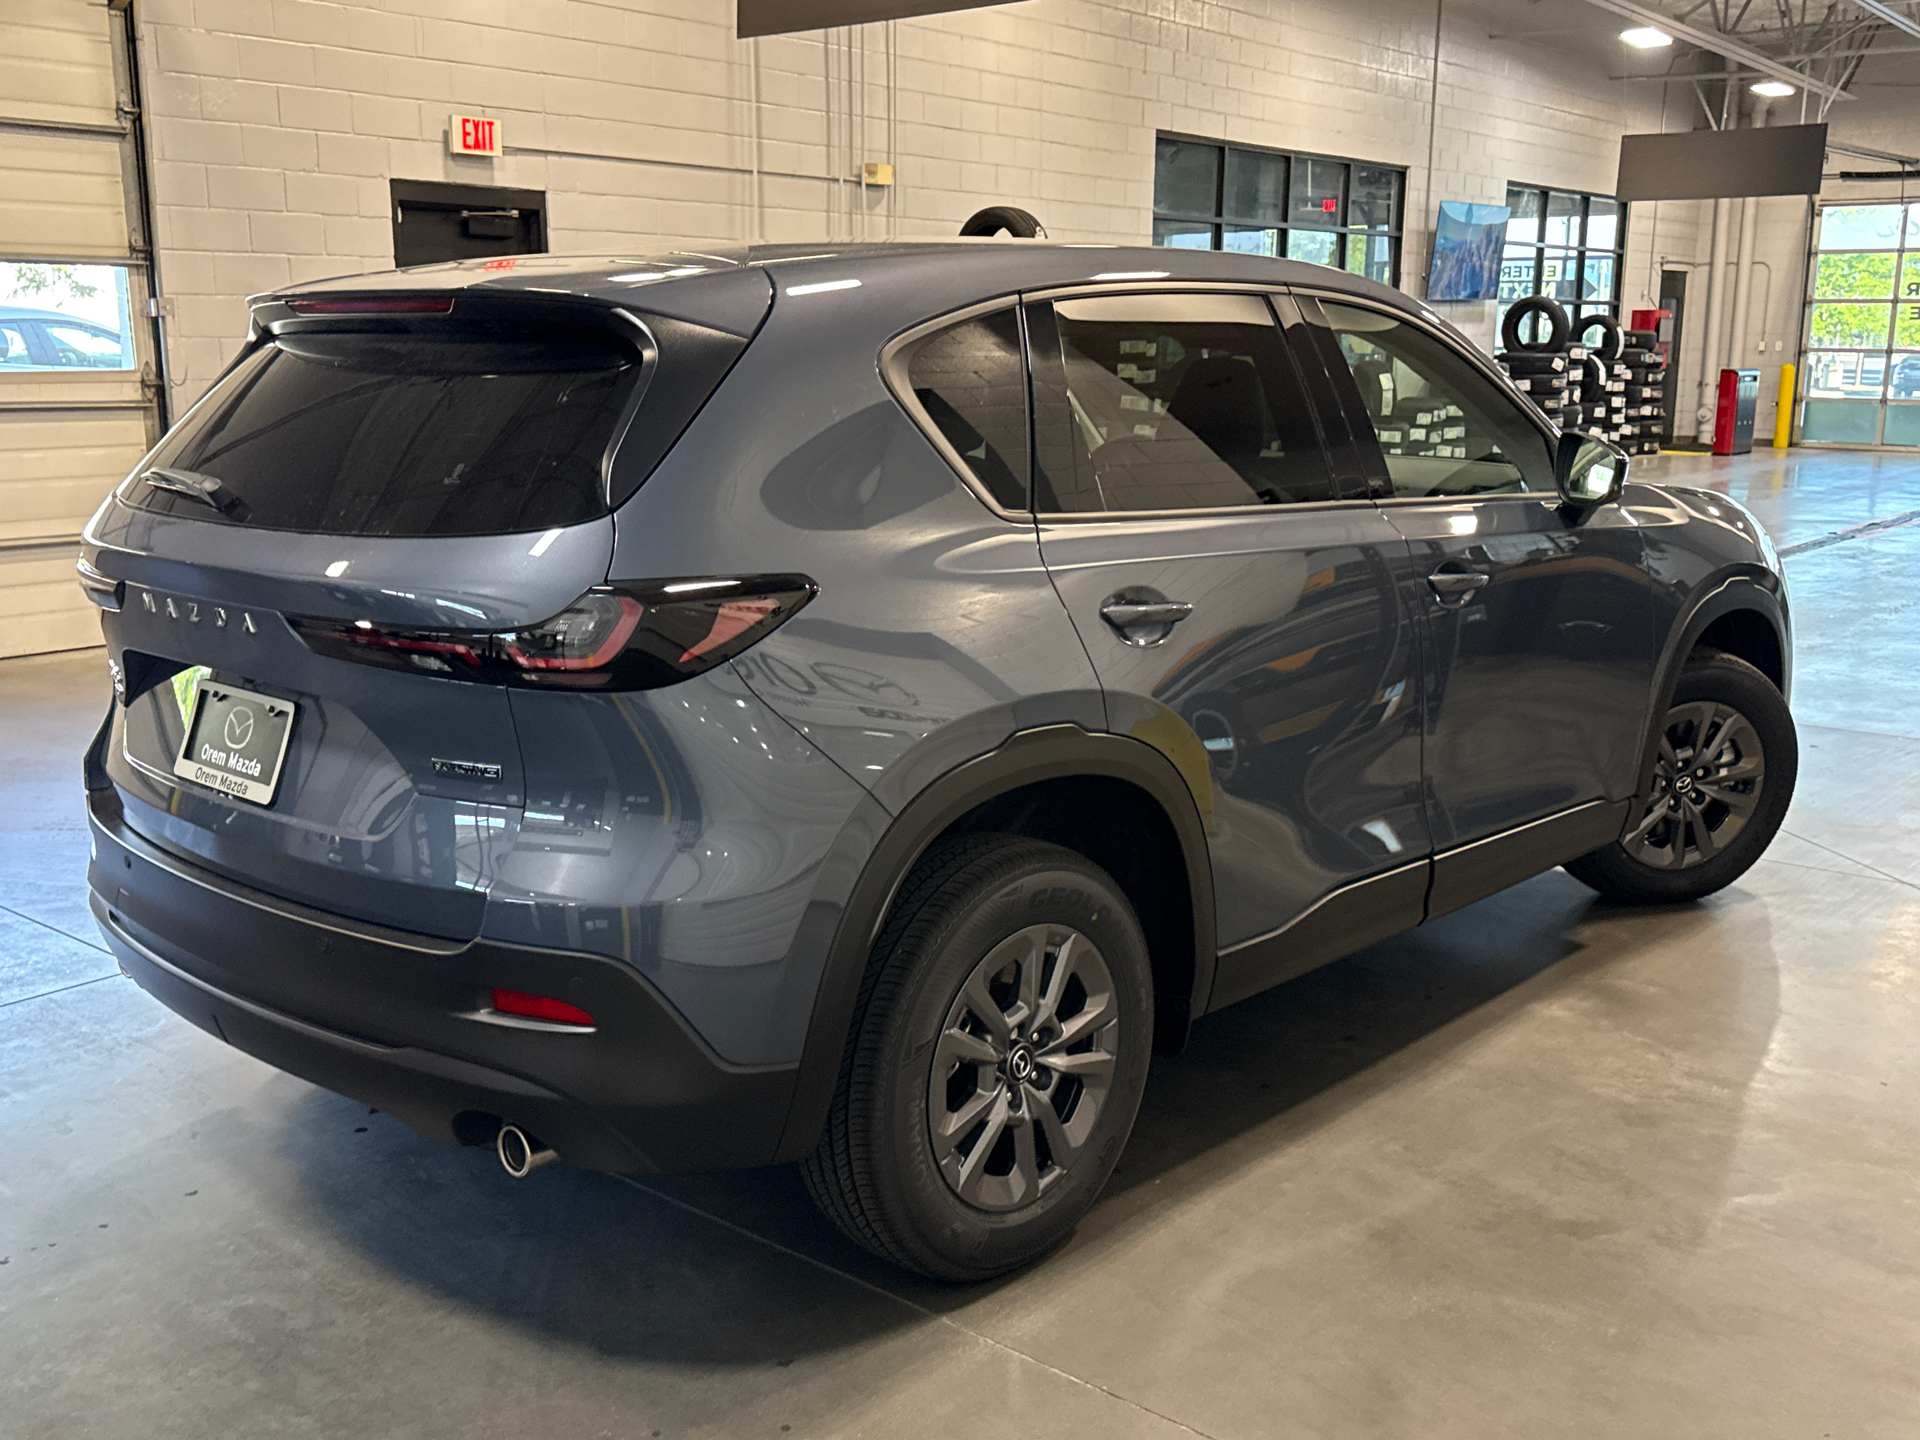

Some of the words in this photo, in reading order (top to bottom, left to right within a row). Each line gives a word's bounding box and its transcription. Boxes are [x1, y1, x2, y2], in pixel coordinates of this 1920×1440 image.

[462, 118, 494, 152] EXIT
[142, 591, 258, 634] MAZDA
[201, 743, 226, 767] Orem
[227, 751, 261, 777] Mazda
[195, 767, 218, 786] Orem
[218, 774, 249, 795] Mazda
